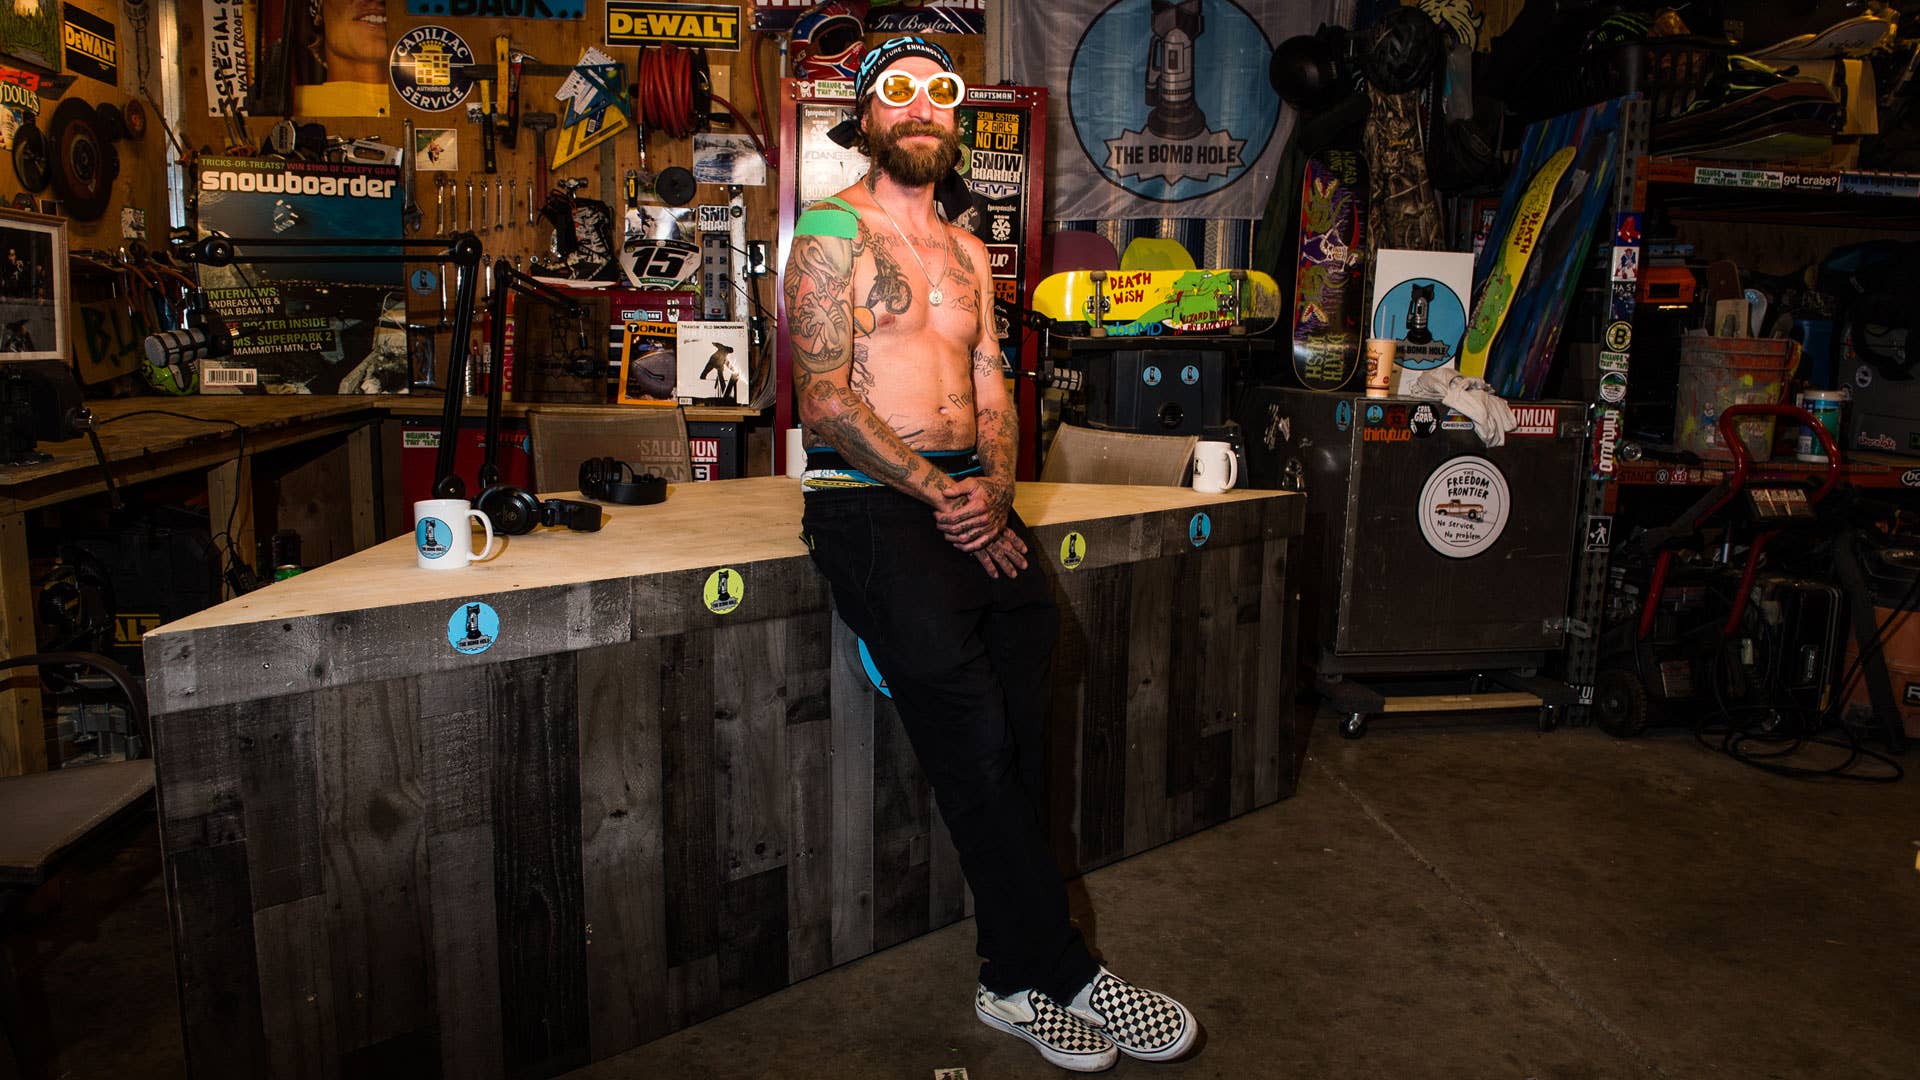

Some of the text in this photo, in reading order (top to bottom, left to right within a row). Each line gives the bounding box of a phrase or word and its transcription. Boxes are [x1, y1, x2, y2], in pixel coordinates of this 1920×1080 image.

[898, 14, 956, 31] Boston
[396, 28, 469, 58] CADILLAC
[402, 86, 464, 109] SERVICE
[970, 91, 1013, 100] CRAFTSMAN
[983, 121, 1013, 133] 2 GIRLS
[975, 132, 1018, 150] NO CUP
[1114, 144, 1236, 164] THE BOMB HOLE
[201, 158, 286, 170] TRICKS-OR-TREATS?
[972, 151, 1022, 172] SNOW
[971, 168, 1021, 183] BOARDER
[1783, 175, 1801, 186] got
[1802, 176, 1838, 186] crabs?
[201, 170, 397, 199] snowboarder
[632, 247, 688, 278] 15
[1109, 272, 1152, 290] DEATH
[273, 297, 280, 305] &
[289, 317, 328, 329] INSIDE
[1105, 321, 1163, 337] cbdMD
[256, 332, 324, 346] SUPERPARK
[325, 332, 332, 341] 2
[1614, 328, 1627, 345] B
[232, 344, 282, 356] MAMMOTH
[310, 342, 322, 351] CA
[1406, 346, 1427, 354] BOMB
[1428, 346, 1446, 354] HOLE
[1414, 412, 1433, 422] GRAB
[1363, 427, 1413, 443] thirtytwo
[1599, 409, 1619, 472] thirtytwo
[1447, 476, 1490, 489] FREEDOM
[1448, 487, 1489, 500] FRONTIER
[1437, 519, 1446, 527] No
[1455, 532, 1481, 540] problem
